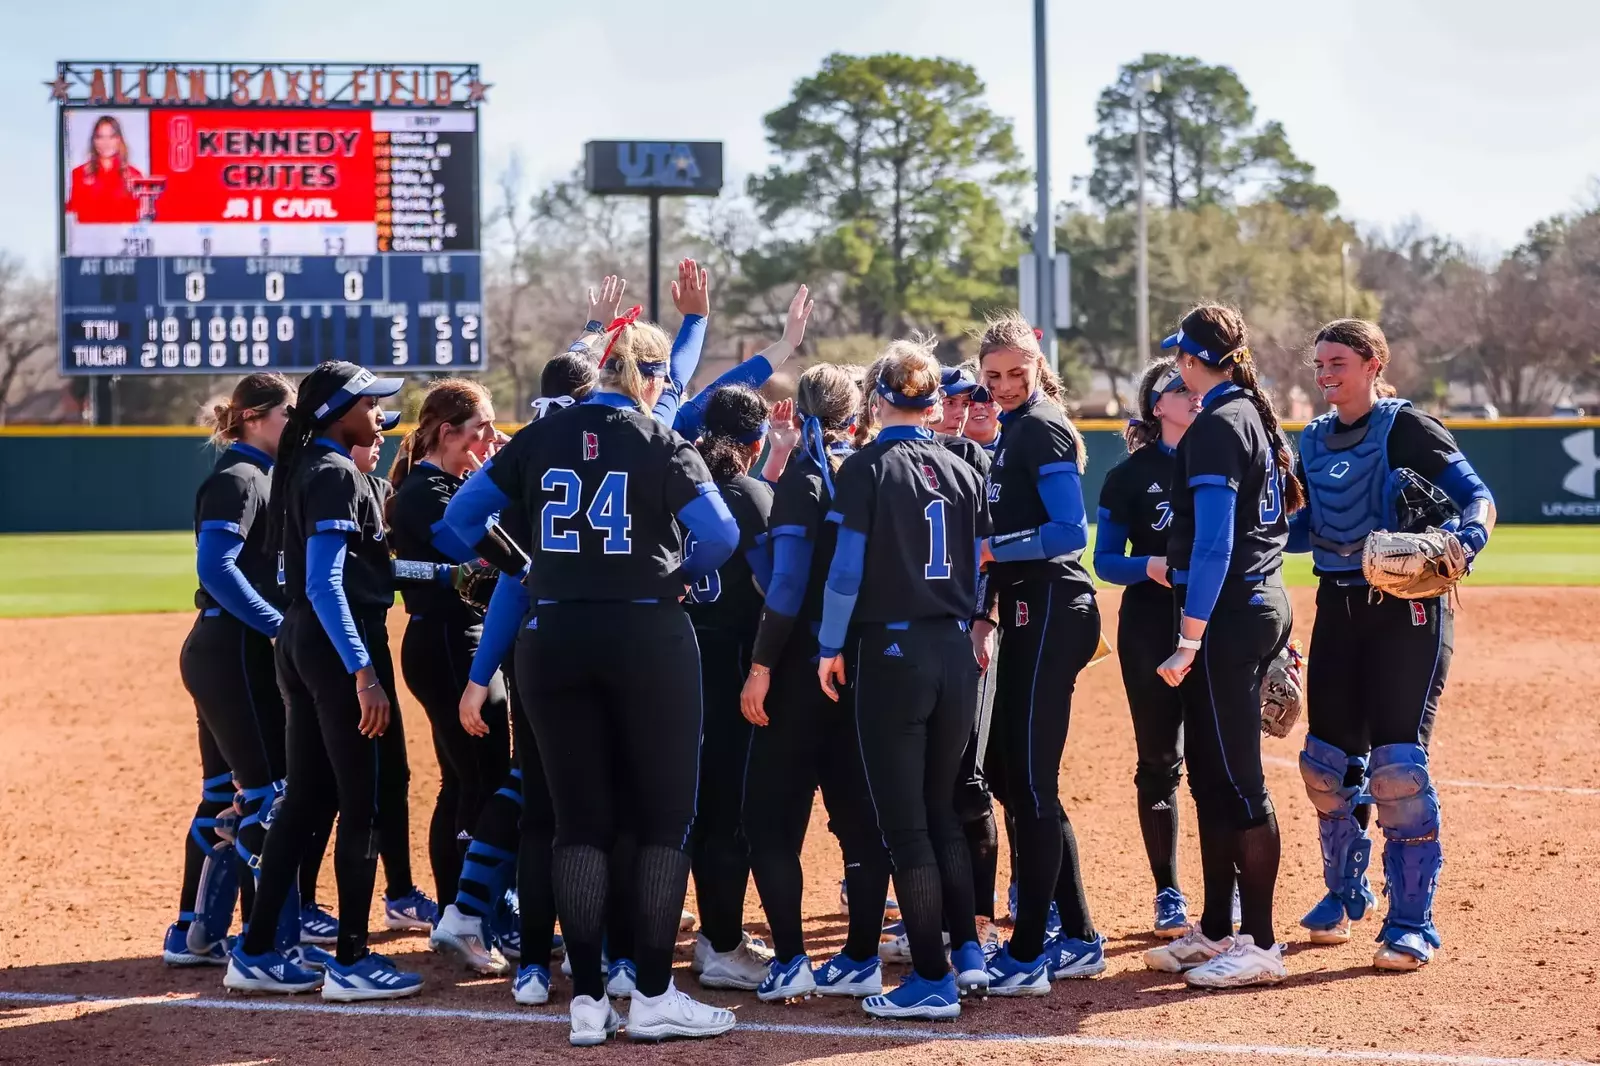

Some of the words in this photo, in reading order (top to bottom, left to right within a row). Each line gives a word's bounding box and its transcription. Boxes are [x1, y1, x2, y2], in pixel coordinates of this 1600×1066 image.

[89, 69, 206, 105] ALLAN
[231, 69, 326, 106] SAXE
[351, 70, 452, 106] FIELD
[197, 130, 360, 157] KENNEDY
[222, 163, 339, 190] CRITES
[617, 143, 702, 186] UTA
[185, 271, 205, 302] 0
[265, 271, 284, 301] 0
[344, 270, 363, 301] 0
[81, 319, 119, 340] TTU
[72, 345, 127, 367] TULSA
[541, 468, 631, 554] 24
[1541, 501, 1600, 516] UNDE
[924, 499, 951, 579] 1
